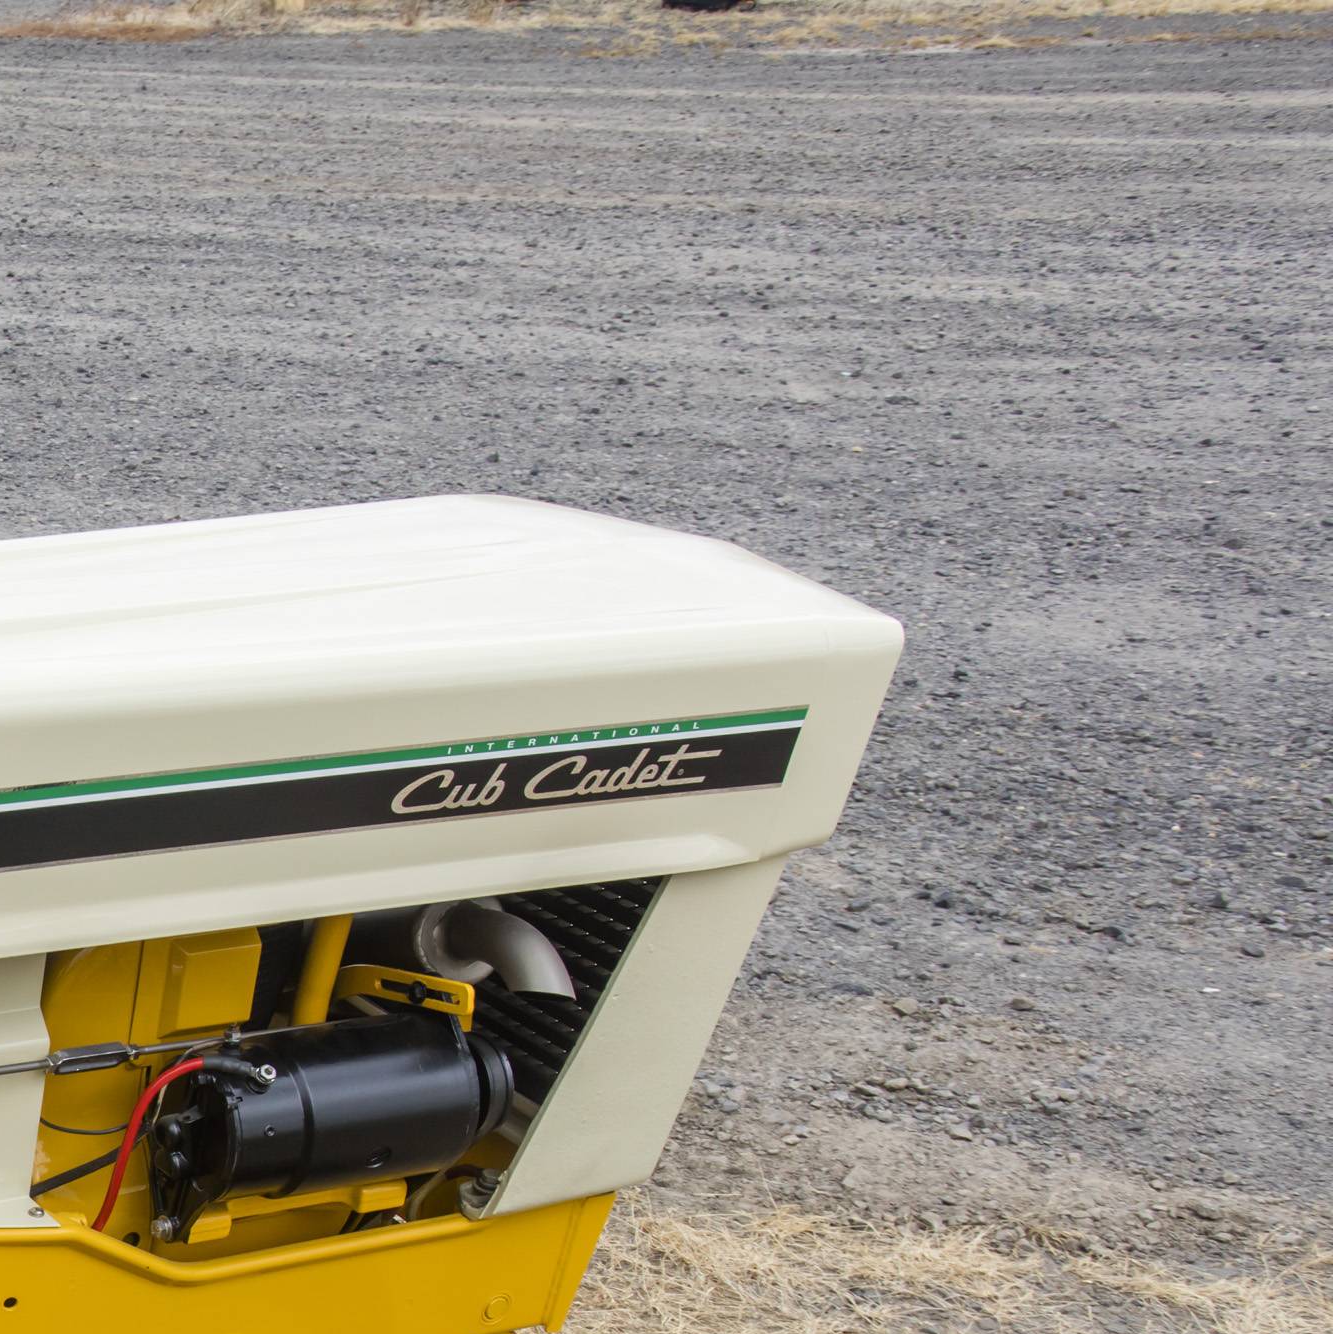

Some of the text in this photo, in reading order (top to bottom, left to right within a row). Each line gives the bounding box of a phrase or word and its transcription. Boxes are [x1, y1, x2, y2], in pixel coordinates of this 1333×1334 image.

[446, 721, 702, 756] INTERNATIONAL
[390, 744, 723, 815] Cub Cadet
